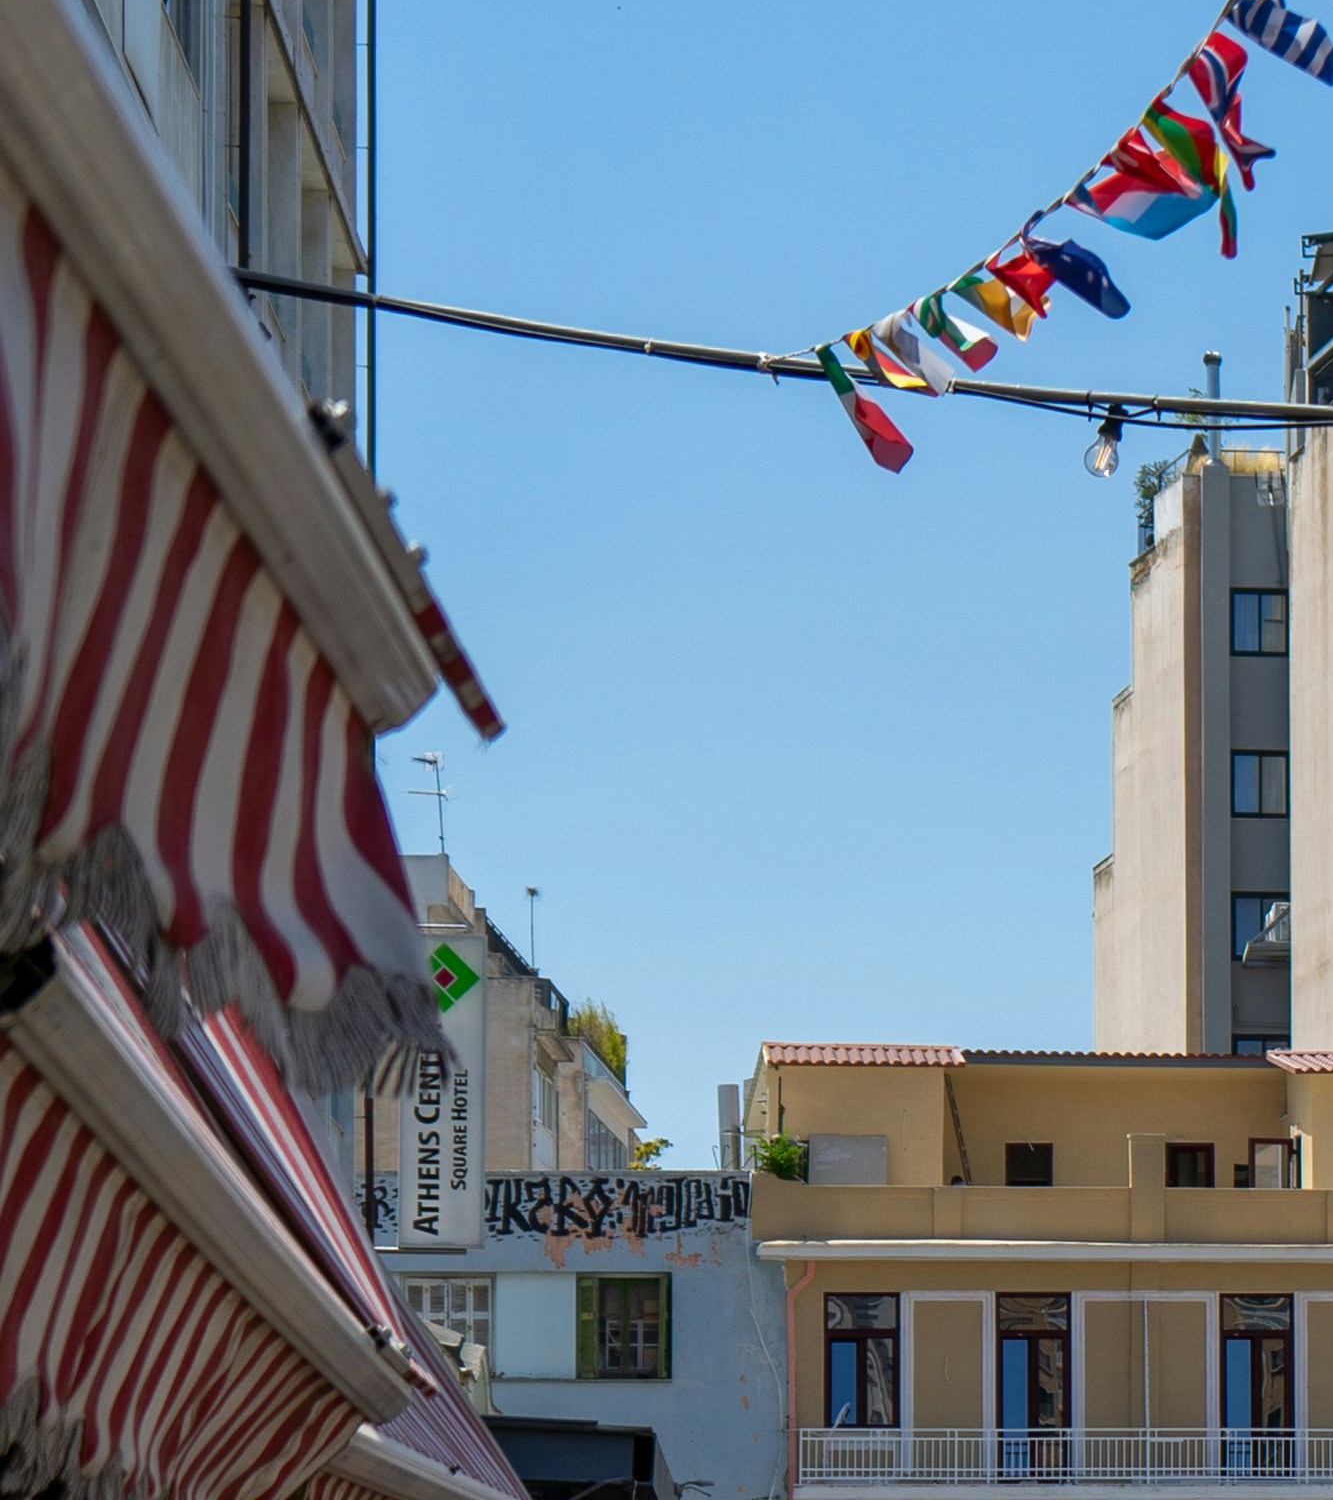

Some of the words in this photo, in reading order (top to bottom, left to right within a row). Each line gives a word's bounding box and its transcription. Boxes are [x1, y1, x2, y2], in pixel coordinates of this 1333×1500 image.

[451, 1069, 468, 1121] HOTEL
[412, 1131, 440, 1236] ATHENS
[451, 1125, 468, 1191] SQUARE
